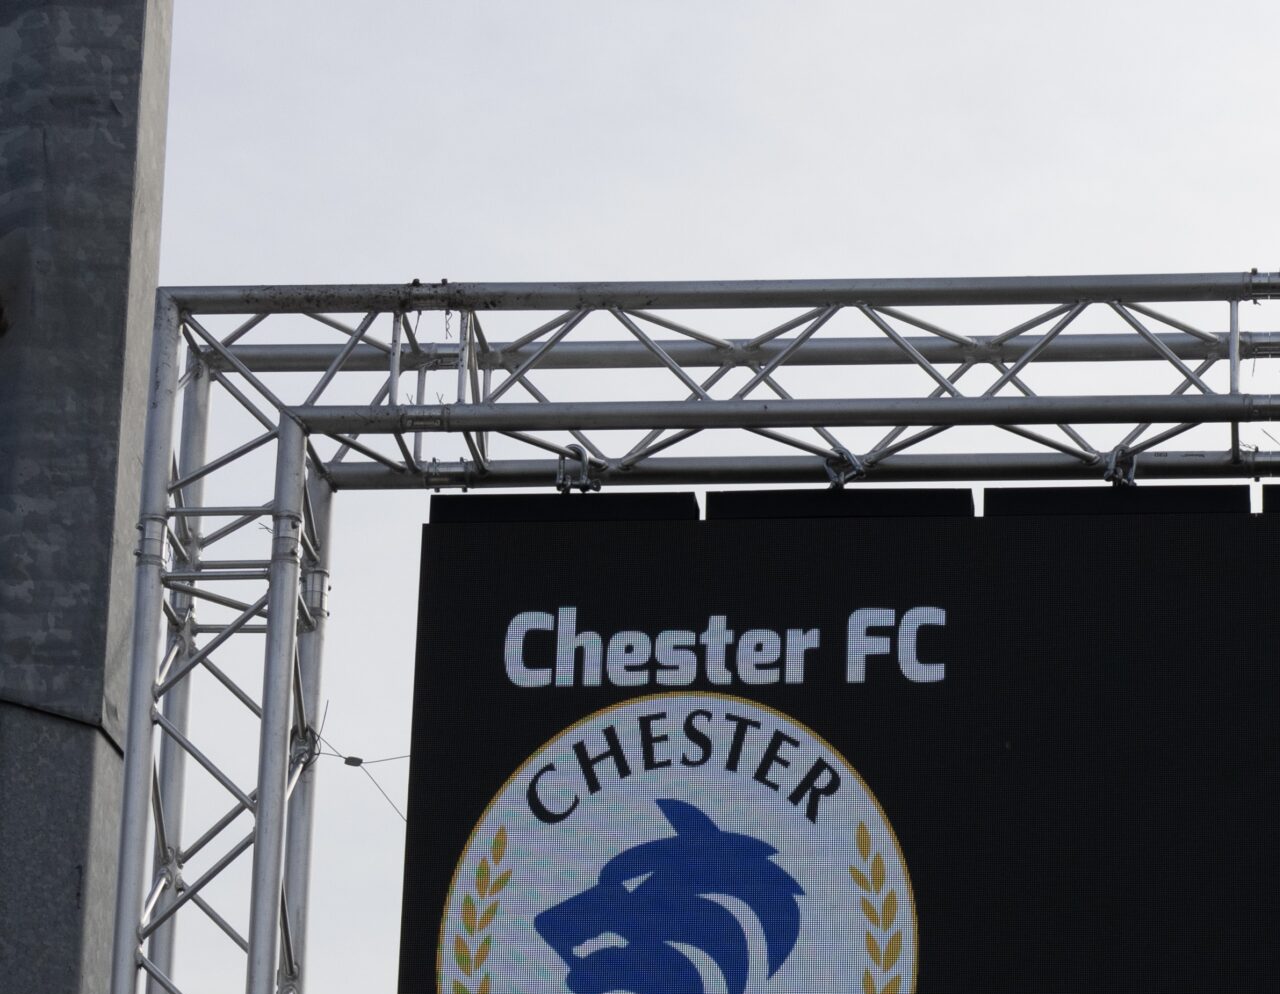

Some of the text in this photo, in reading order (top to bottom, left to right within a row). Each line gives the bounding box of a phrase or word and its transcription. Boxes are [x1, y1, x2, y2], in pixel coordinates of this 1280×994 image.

[504, 606, 946, 688] Chester FC
[525, 709, 842, 825] CHESTER
